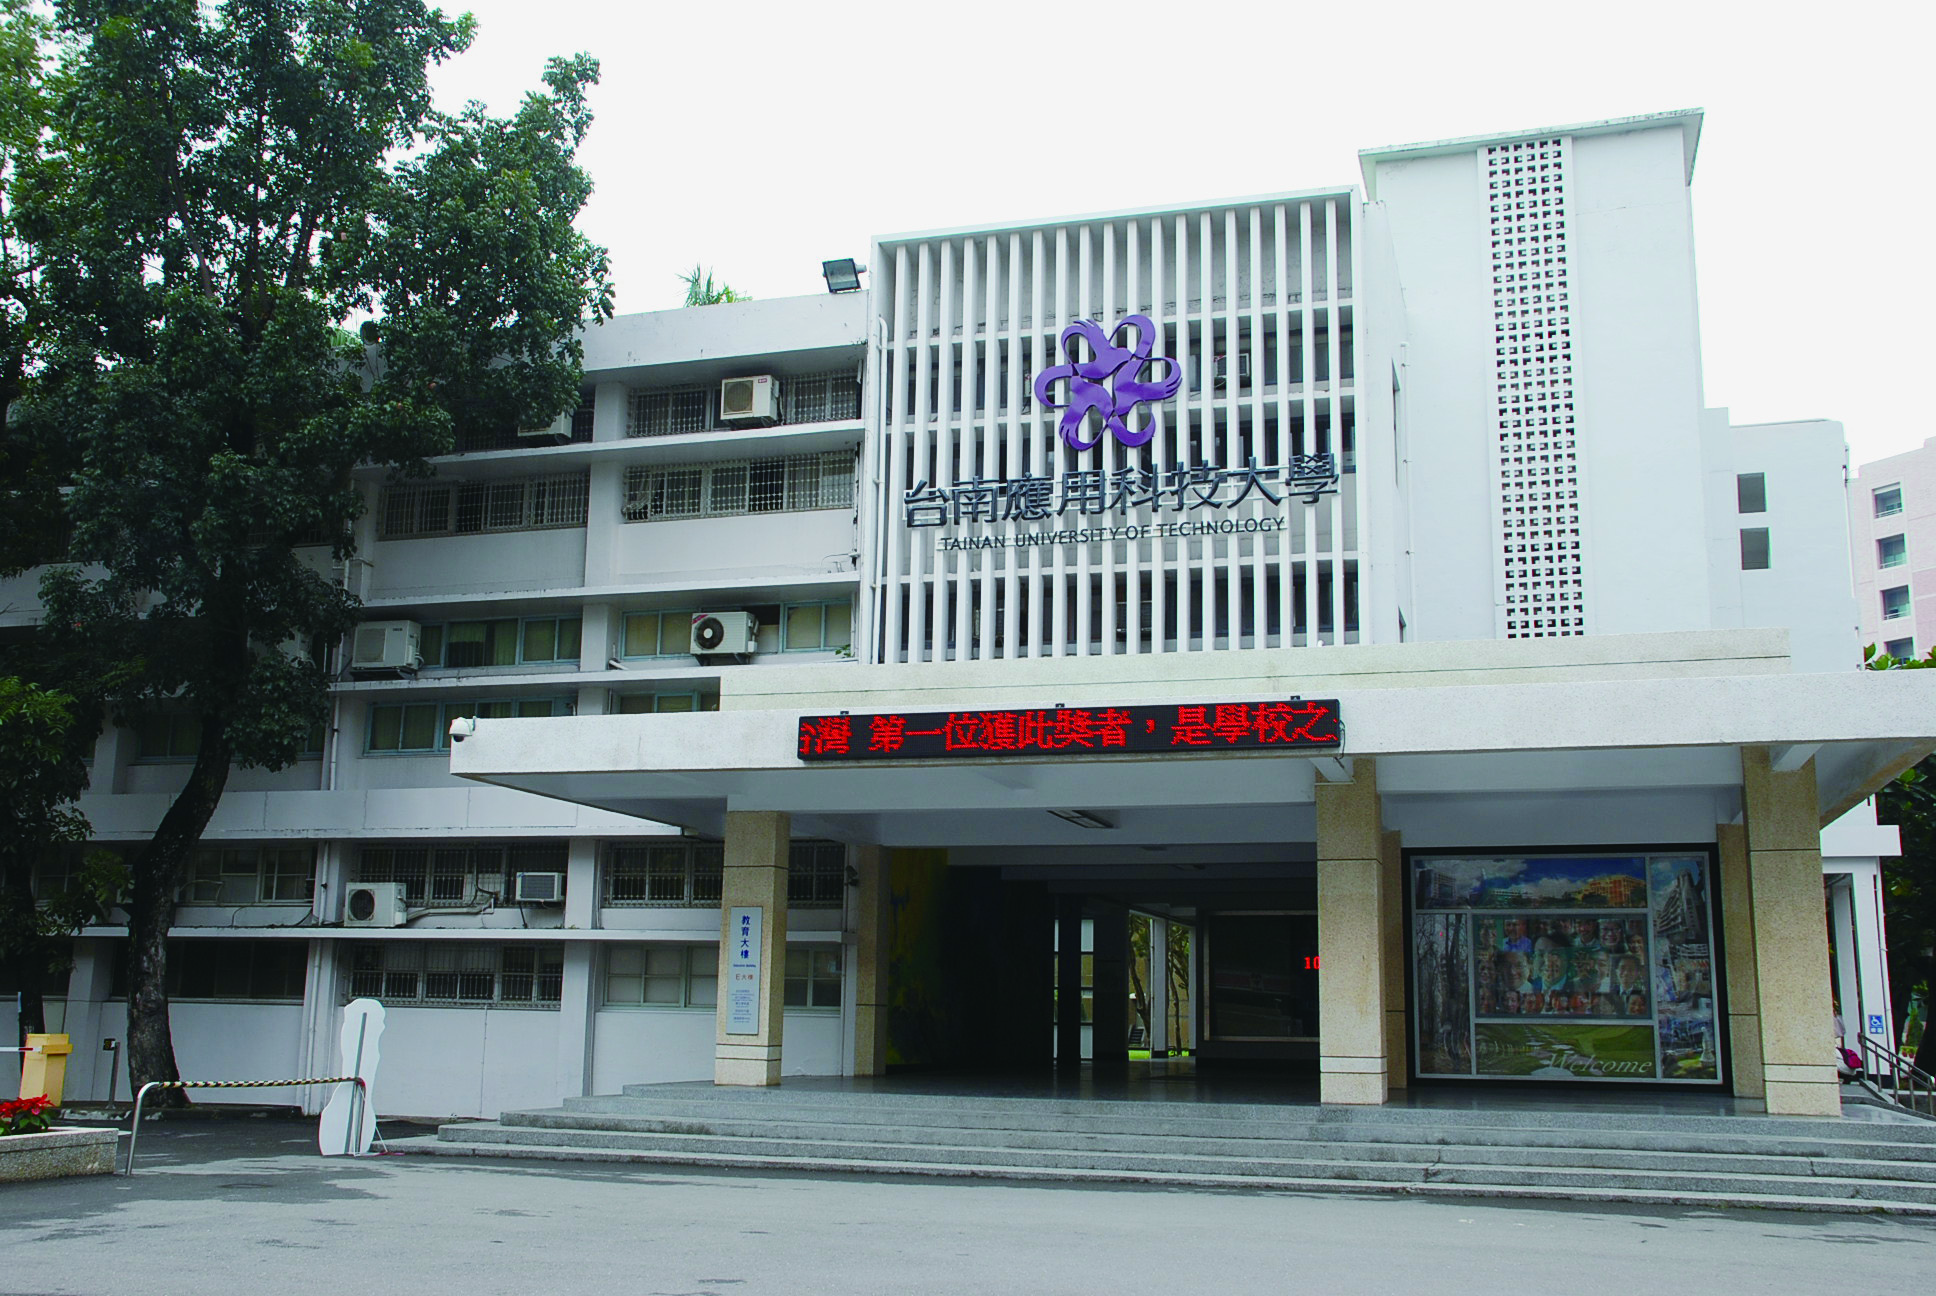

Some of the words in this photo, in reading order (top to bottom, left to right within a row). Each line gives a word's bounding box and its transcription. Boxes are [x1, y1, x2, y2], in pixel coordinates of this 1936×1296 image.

[904, 453, 1340, 528] 台南應用科技大學
[941, 535, 1006, 551] TAINAN
[1015, 526, 1121, 548] UNIVERSITY
[1125, 523, 1150, 541] OF
[1156, 516, 1285, 537] TECHNOLOGY
[740, 915, 750, 958] 教育大樓
[1550, 1053, 1653, 1073] Welcome
